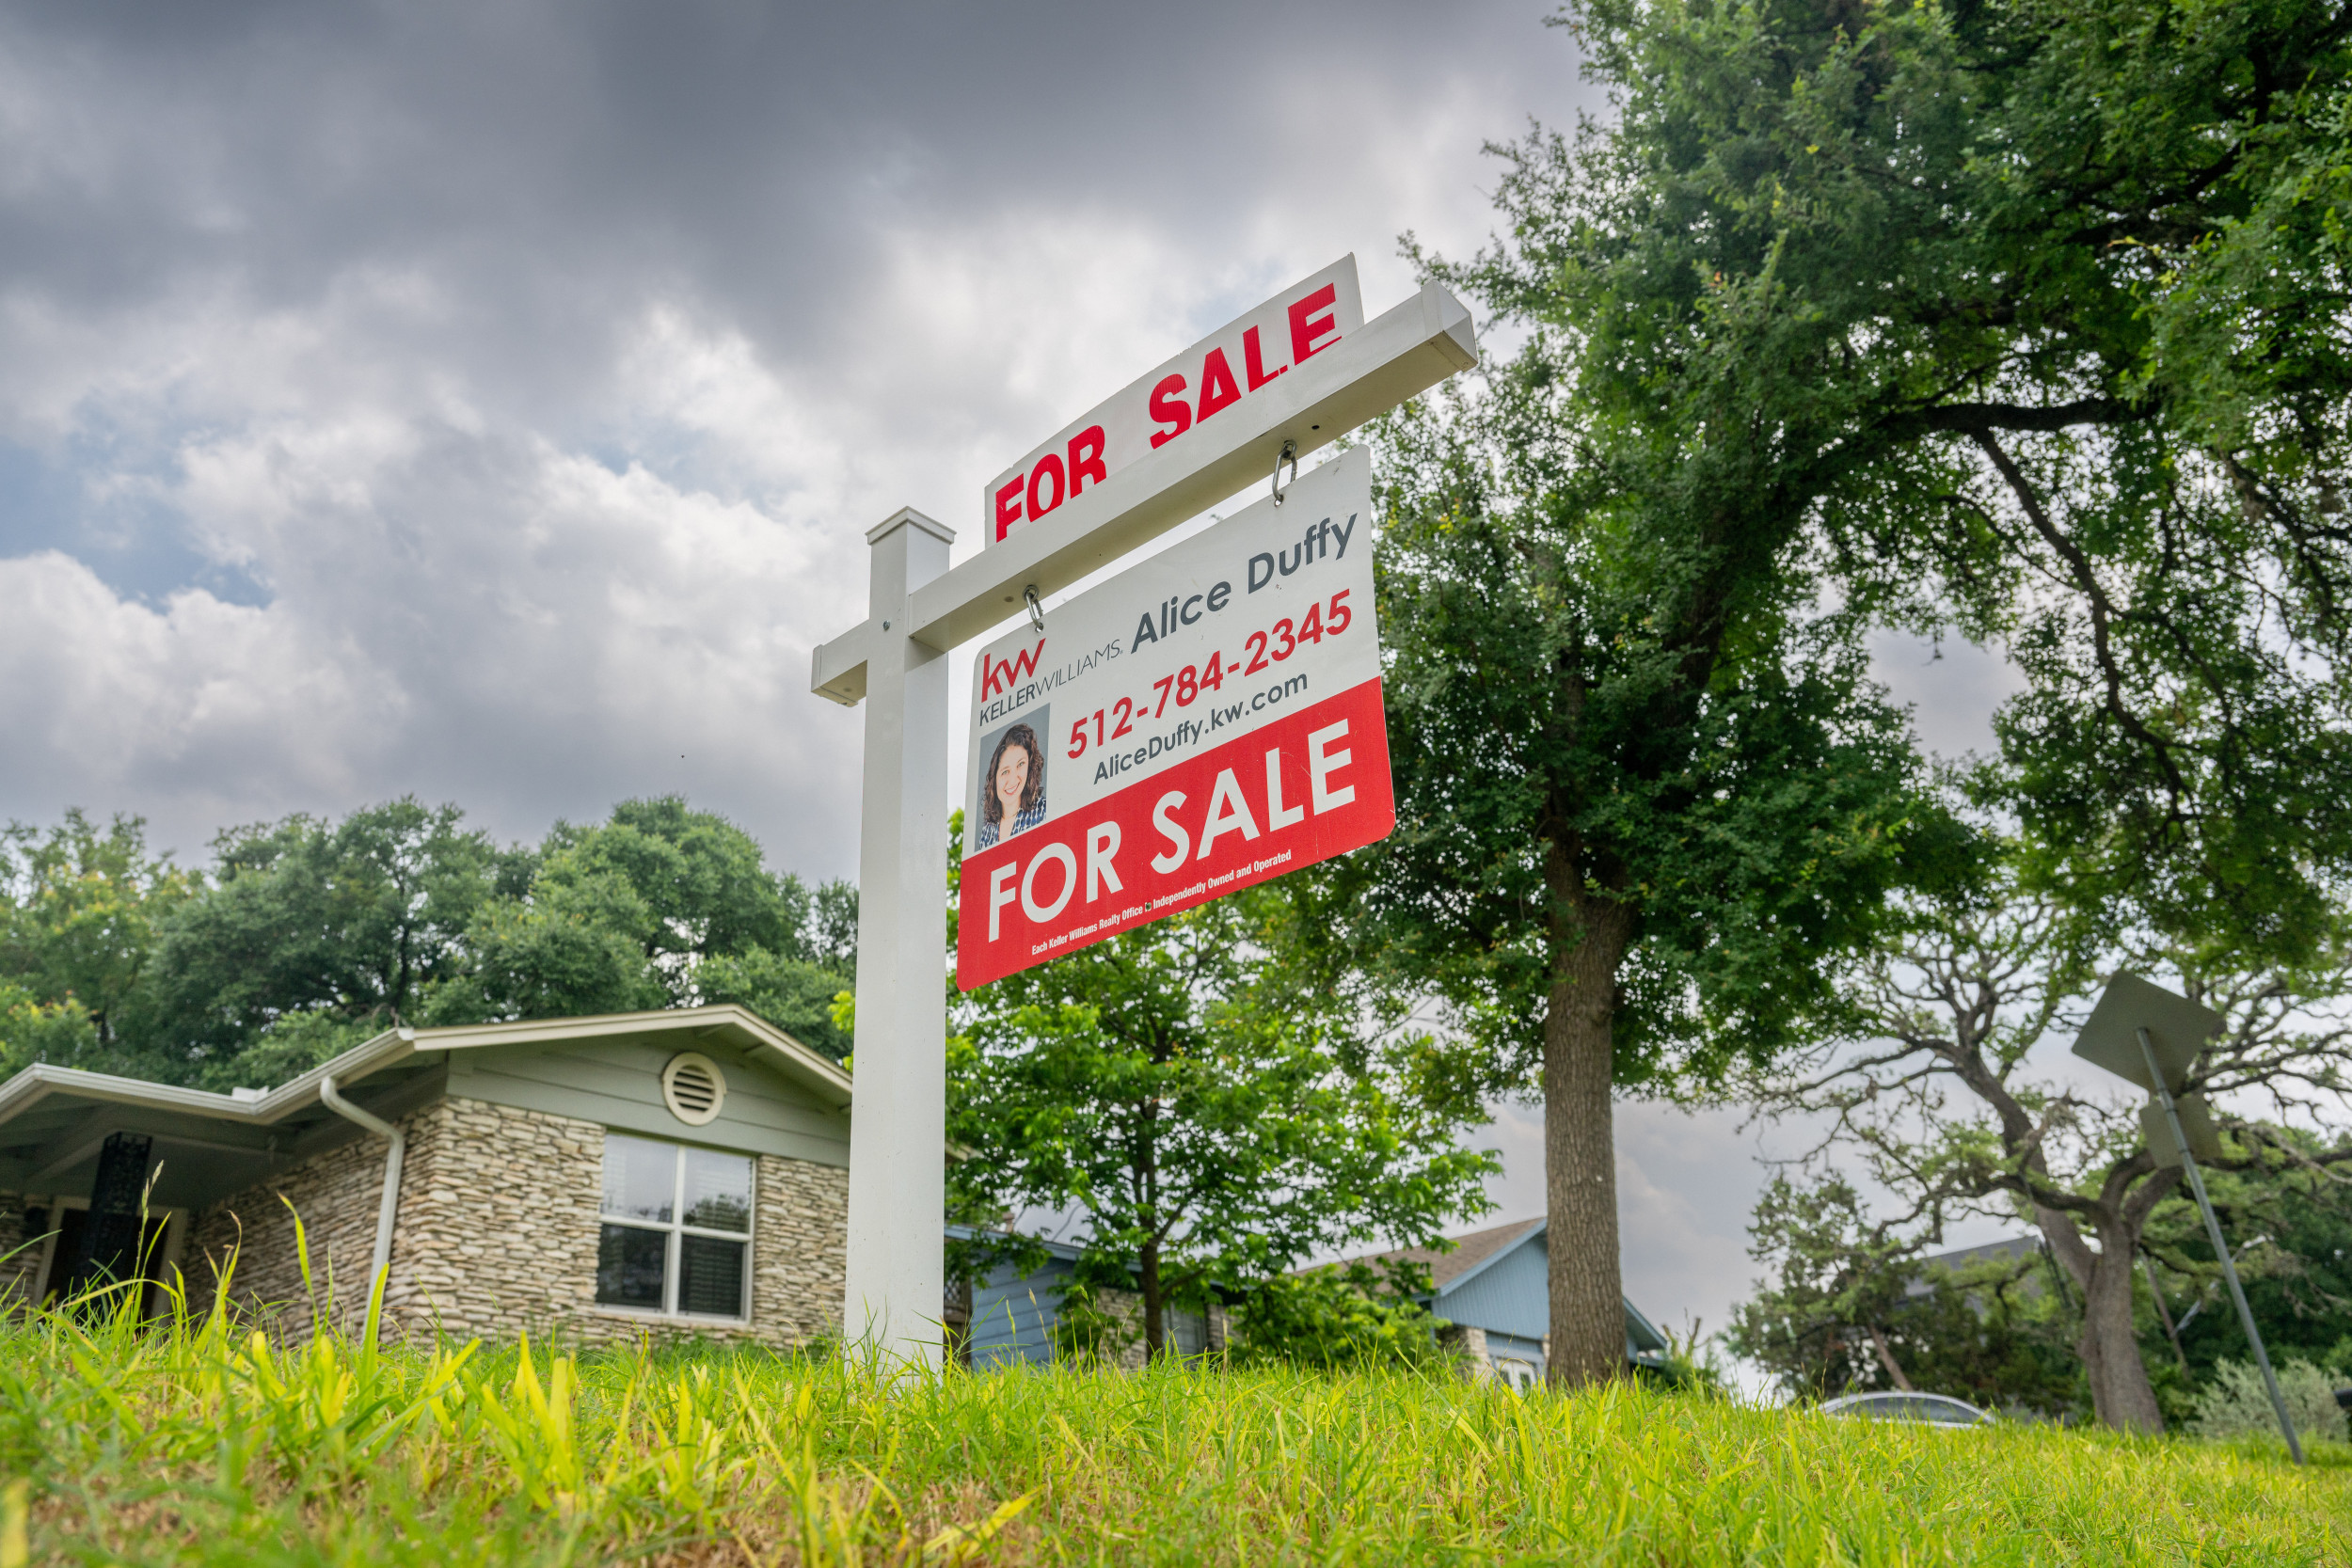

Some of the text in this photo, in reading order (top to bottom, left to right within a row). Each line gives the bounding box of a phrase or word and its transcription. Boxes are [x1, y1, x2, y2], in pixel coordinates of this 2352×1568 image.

[995, 282, 1343, 544] FOR SALE
[1130, 513, 1358, 655] Alice Duffy
[981, 637, 1046, 704] kw
[1067, 588, 1352, 759] 512-784-2345
[1093, 673, 1308, 784] AliceDuffy.kw.com
[988, 719, 1355, 942] FOR SALE
[1032, 942, 1047, 956] Each
[1049, 935, 1068, 949] Keller
[1069, 924, 1098, 942] Williams
[1099, 913, 1120, 929] Realty
[1121, 905, 1143, 921] Office
[1153, 881, 1206, 909] Independently
[1208, 870, 1234, 889] Owned
[1236, 863, 1252, 879] and
[1254, 849, 1292, 872] Operated
